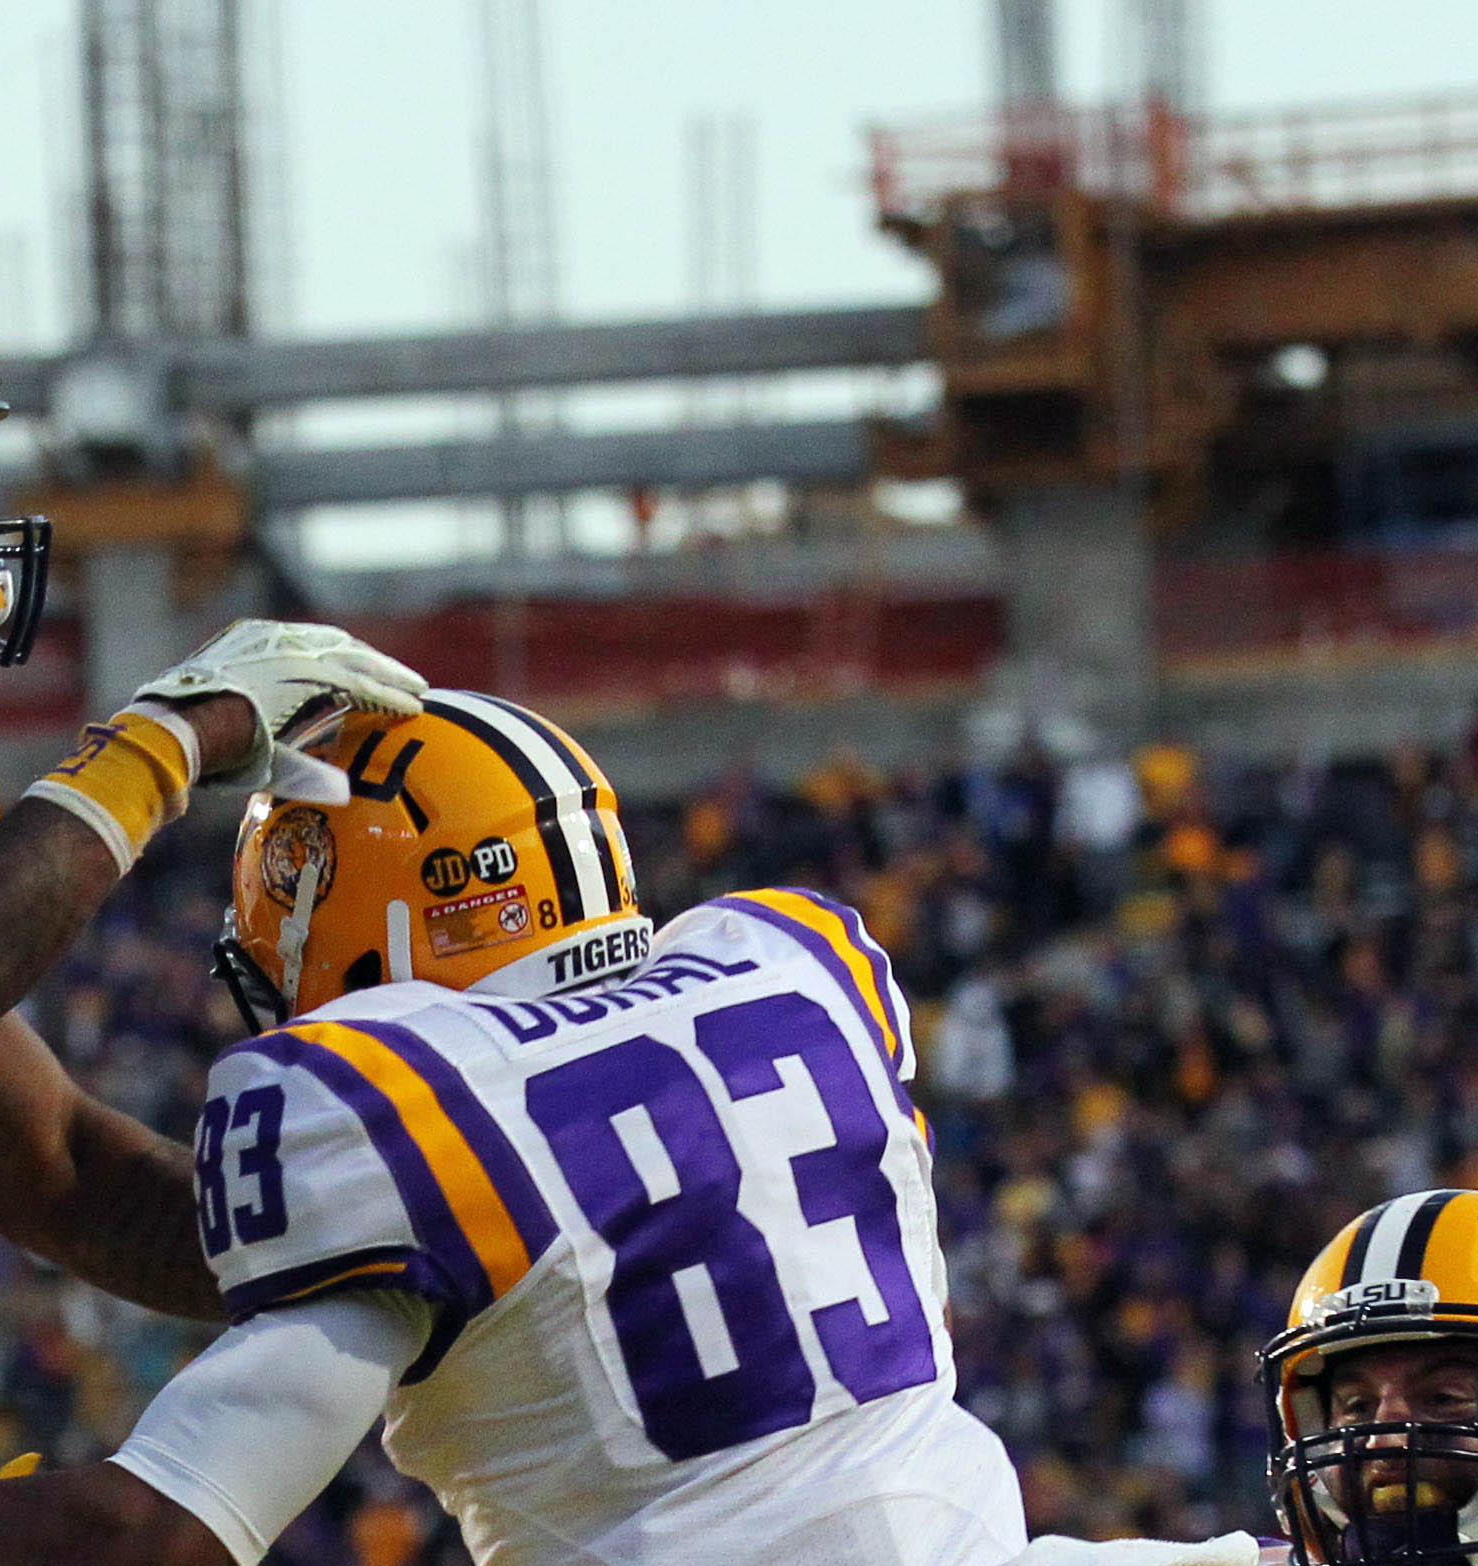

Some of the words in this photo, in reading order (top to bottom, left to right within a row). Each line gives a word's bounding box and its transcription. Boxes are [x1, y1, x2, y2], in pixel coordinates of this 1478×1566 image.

[426, 854, 465, 890] JD
[473, 841, 516, 880] PD
[443, 888, 520, 914] DANGER
[537, 898, 558, 930] 8
[547, 926, 650, 985] TIGERS
[196, 1084, 287, 1259] 83
[525, 991, 938, 1462] 83
[1345, 1282, 1406, 1309] LSU
